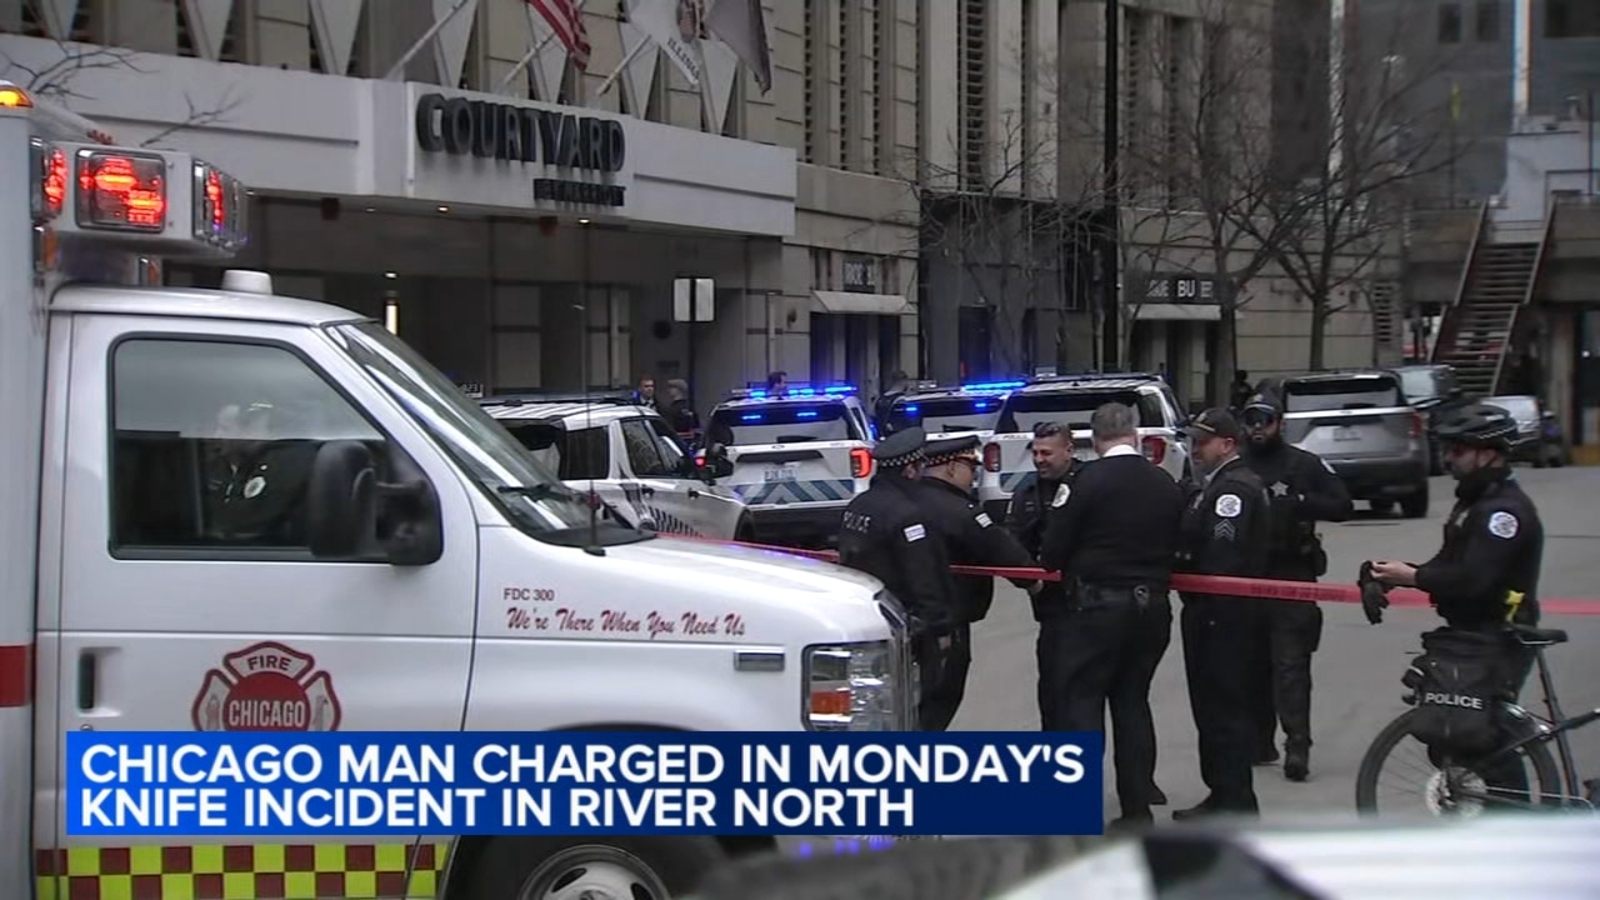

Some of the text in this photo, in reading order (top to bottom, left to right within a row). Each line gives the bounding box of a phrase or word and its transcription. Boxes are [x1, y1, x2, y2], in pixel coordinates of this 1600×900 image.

[416, 93, 625, 172] COURTYARD
[503, 588, 555, 602] FDC 300
[507, 607, 745, 639] We're There When You Need Us
[247, 654, 292, 671] FIRE
[1424, 692, 1483, 710] POLICE
[229, 701, 306, 727] CHICAGO
